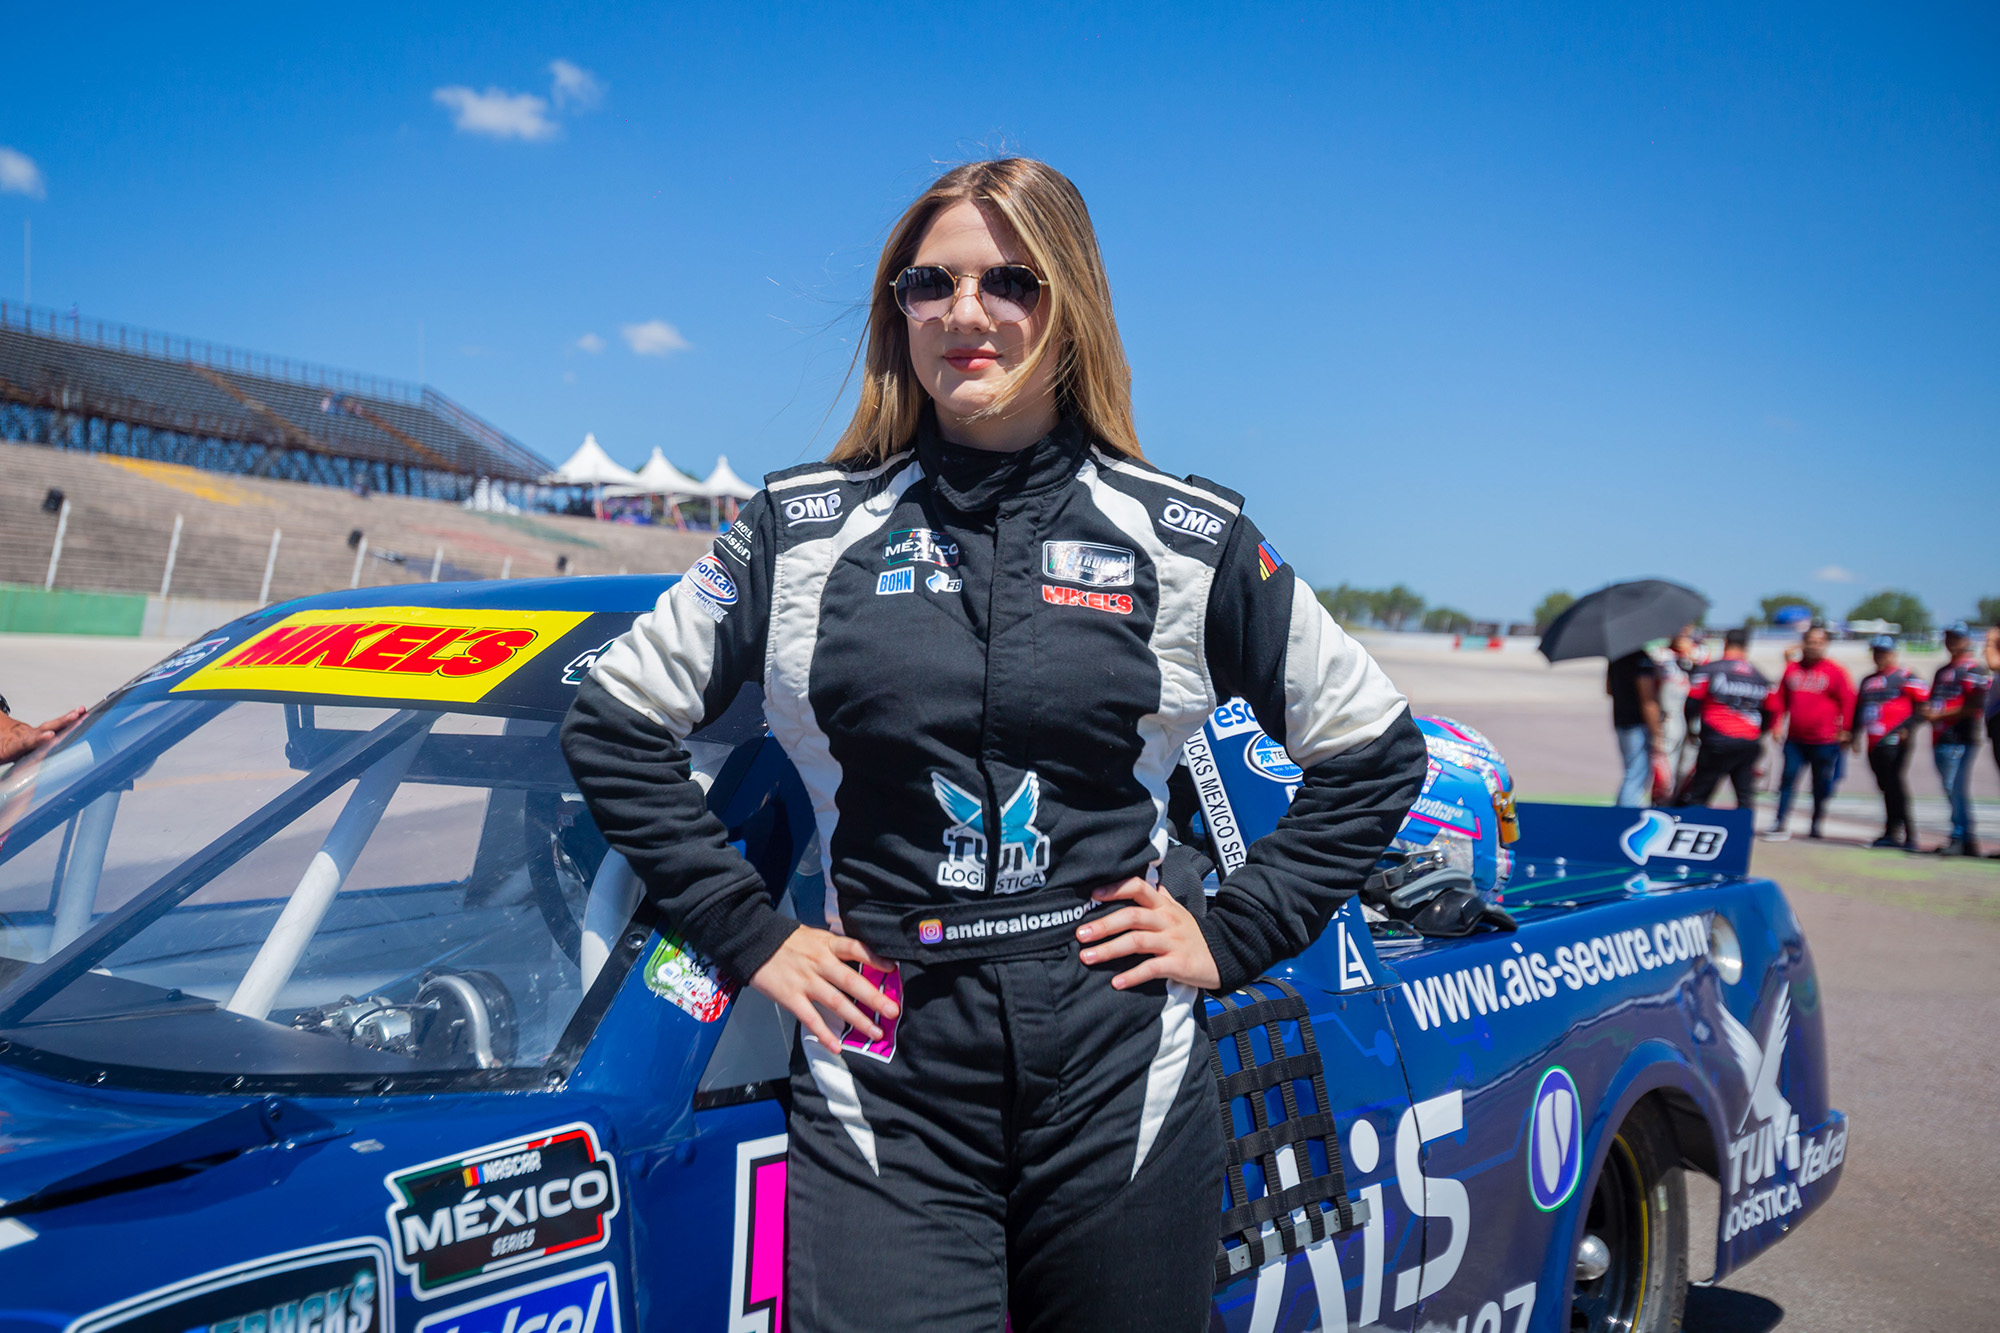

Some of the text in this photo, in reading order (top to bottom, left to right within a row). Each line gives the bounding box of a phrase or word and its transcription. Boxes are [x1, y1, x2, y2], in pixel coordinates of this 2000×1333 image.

[786, 494, 842, 520] OMP
[1163, 504, 1223, 536] OMP
[879, 570, 912, 593] BOHN
[946, 580, 961, 590] FB
[1042, 584, 1134, 615] MIKEL'S
[215, 621, 539, 678] MIKEL'S
[1185, 731, 1214, 776] UCKS
[1200, 777, 1236, 839] MEXICO
[1221, 841, 1248, 870] SER
[1667, 828, 1722, 855] FB
[1402, 914, 1709, 1031] www.ais-secure.com
[482, 1150, 543, 1184] NASCAR
[401, 1169, 609, 1256] MÉXICO
[491, 1228, 537, 1257] SERIES
[208, 1280, 378, 1333] UCKS
[449, 1280, 607, 1333] lcel
